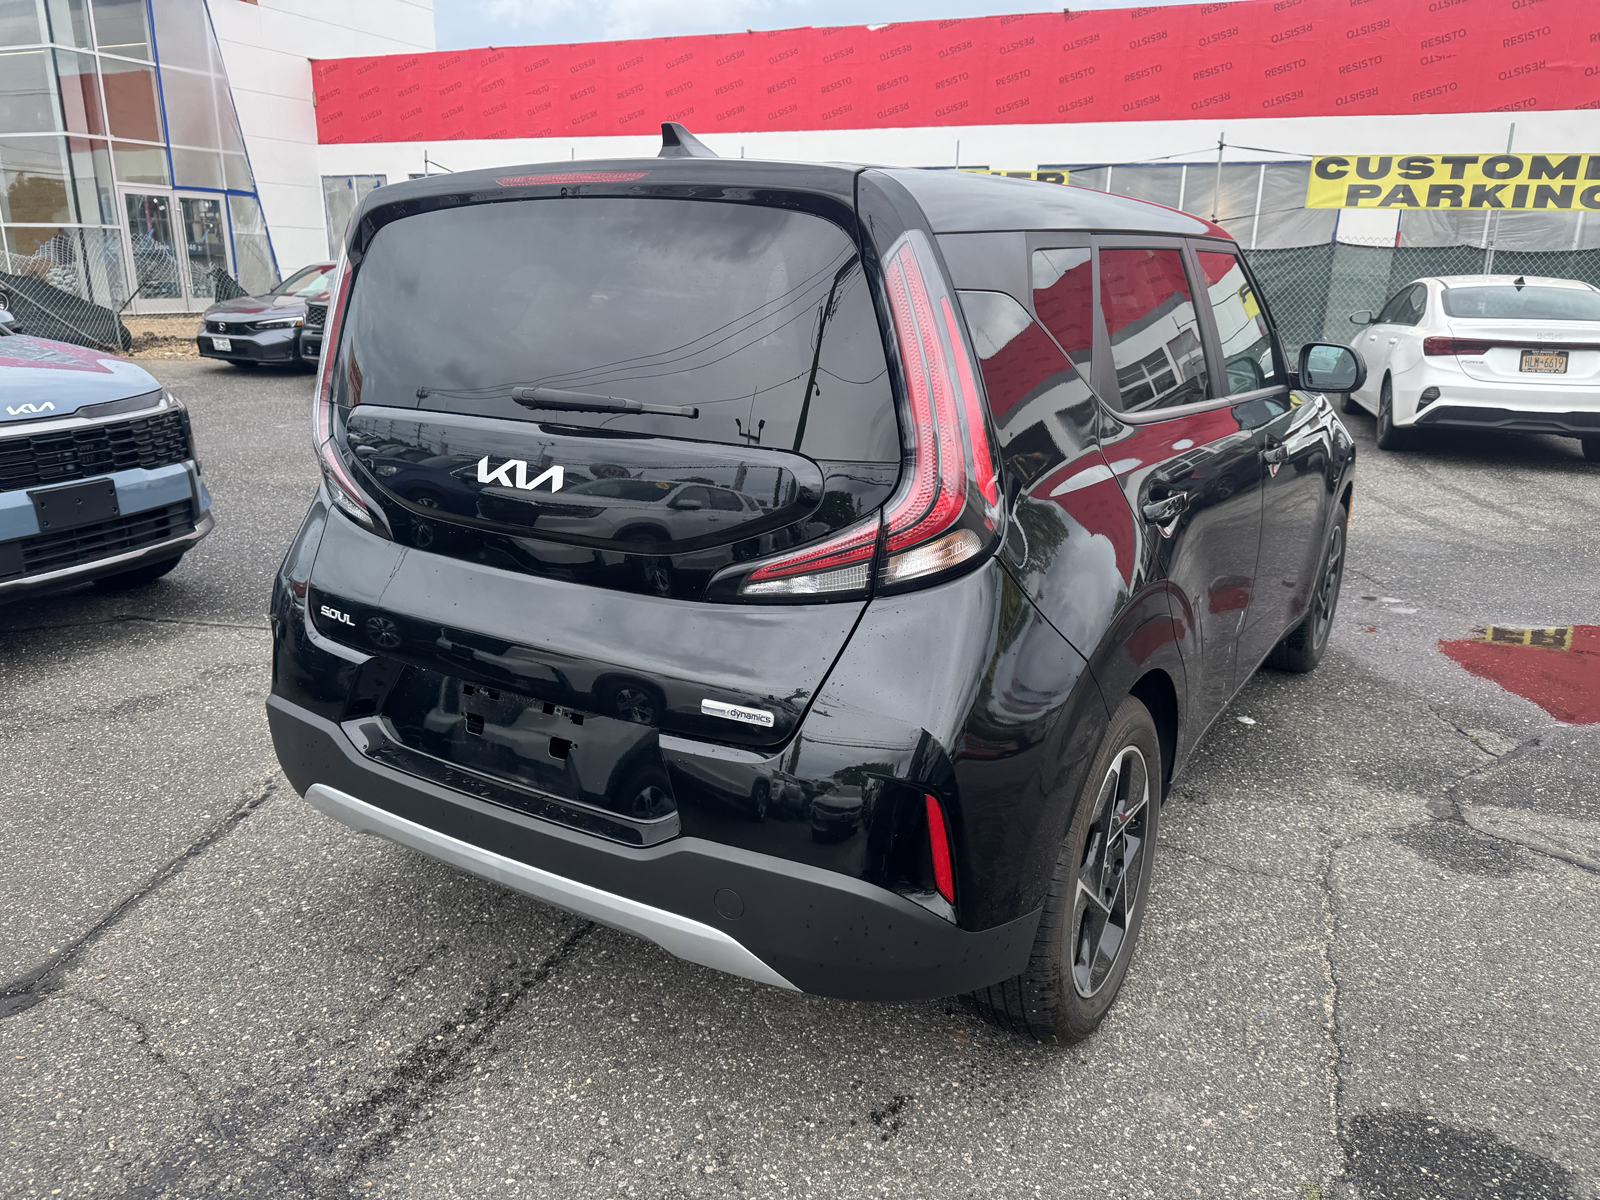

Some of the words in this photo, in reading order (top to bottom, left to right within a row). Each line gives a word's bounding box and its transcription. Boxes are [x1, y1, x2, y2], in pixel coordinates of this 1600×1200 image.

[1131, 5, 1169, 20] RESIS
[1200, 0, 1241, 17] RESIS
[1273, 0, 1309, 13] RESIS
[1429, 0, 1467, 12] SISTO
[1001, 13, 1036, 27] RESIS
[1064, 9, 1098, 23] RESIS
[939, 18, 973, 31] RESIS
[1346, 18, 1391, 39] RESISTO
[1129, 30, 1169, 50] RESISTO
[1198, 26, 1239, 46] RESISTO
[1271, 23, 1313, 43] RESISTO
[1420, 28, 1467, 50] RESISTO
[1502, 25, 1551, 48] RESISTO
[938, 40, 973, 58] RESISTO
[999, 36, 1035, 54] RESISTO
[1063, 33, 1101, 51] RESISTO
[481, 52, 504, 67] RESISTO
[665, 53, 694, 69] RESISTO
[715, 50, 745, 66] RESISTO
[768, 47, 799, 64] RESISTO
[823, 47, 855, 64] RESISTO
[879, 45, 913, 61] RESISTO
[318, 63, 339, 77] RESISTO
[357, 61, 379, 74] RESISTO
[396, 58, 419, 72] RESISTO
[438, 56, 461, 70] RESISTO
[524, 59, 551, 72] RESISTO
[570, 59, 597, 73] RESISTO
[617, 57, 645, 72] RESISTO
[1193, 61, 1233, 80] RESISTO
[1264, 58, 1307, 78] RESISTO
[1338, 55, 1383, 75] RESISTO
[1498, 59, 1547, 80] RESISTO
[935, 72, 969, 90] RESISTO
[995, 69, 1031, 86] RESISTO
[1059, 66, 1096, 84] RESISTO
[1124, 64, 1163, 82] RESISTO
[397, 84, 420, 97] RESISTO
[438, 82, 462, 96] RESISTO
[481, 78, 505, 93] RESISTO
[616, 83, 644, 100] RESISTO
[665, 81, 693, 97] RESISTO
[715, 79, 745, 96] RESISTO
[767, 77, 797, 94] RESISTO
[821, 77, 853, 94] RESISTO
[877, 75, 910, 92] RESISTO
[1412, 81, 1459, 102] RESISTO
[320, 88, 341, 102] RESISTO
[358, 87, 380, 100] RESISTO
[569, 85, 597, 100] RESISTO
[1191, 91, 1231, 110] RESISTO
[1262, 89, 1305, 108] RESISTO
[1335, 86, 1379, 106] RESISTO
[483, 103, 507, 115] RESISTO
[527, 103, 552, 116] RESISTO
[877, 102, 910, 119] RESISTO
[935, 100, 969, 117] RESISTO
[995, 98, 1030, 114] RESISTO
[1057, 95, 1095, 113] RESISTO
[1122, 93, 1161, 112] RESISTO
[322, 112, 343, 124] RESISTO
[361, 110, 383, 123] RESISTO
[400, 106, 423, 121] RESISTO
[441, 106, 464, 118] RESISTO
[571, 110, 598, 125] RESISTO
[619, 109, 646, 124] RESISTO
[716, 105, 745, 121] RESISTO
[768, 104, 798, 120] RESISTO
[821, 103, 853, 120] RESISTO
[6, 401, 55, 415] KIA
[477, 455, 564, 494] KIA
[320, 605, 355, 626] SOUL
[730, 709, 771, 724] dynamics
